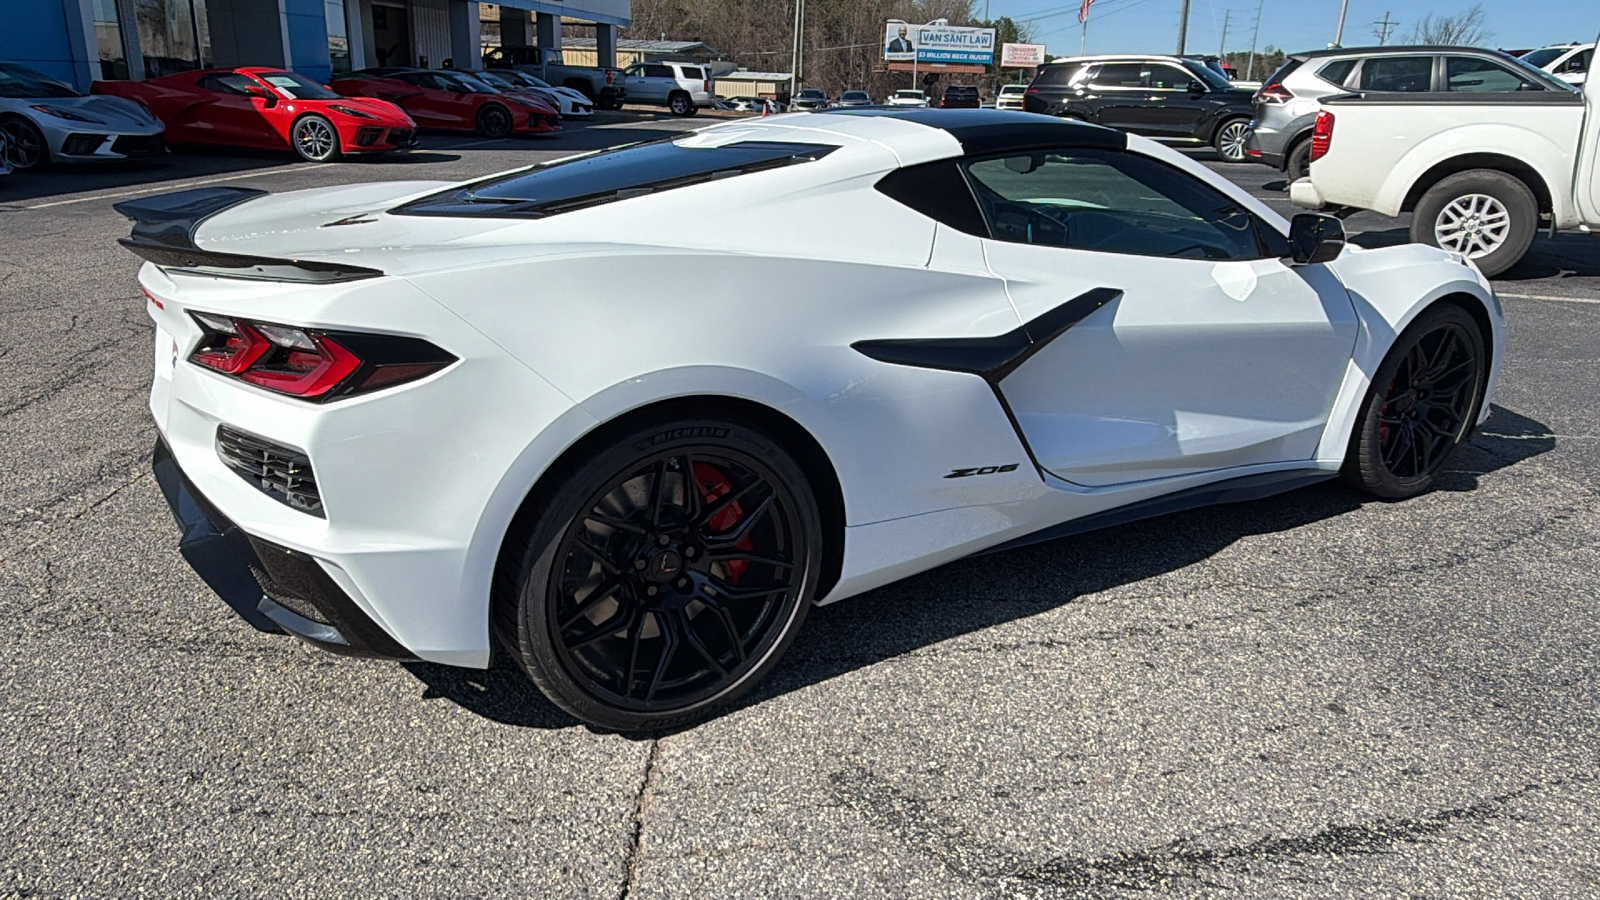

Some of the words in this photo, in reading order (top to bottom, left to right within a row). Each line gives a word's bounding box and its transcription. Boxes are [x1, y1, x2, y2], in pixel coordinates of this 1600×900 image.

[923, 33, 942, 42] VAN
[943, 33, 967, 43] SANT
[969, 34, 989, 44] LAW
[968, 53, 991, 61] INJURY
[654, 427, 725, 443] MICHELIN
